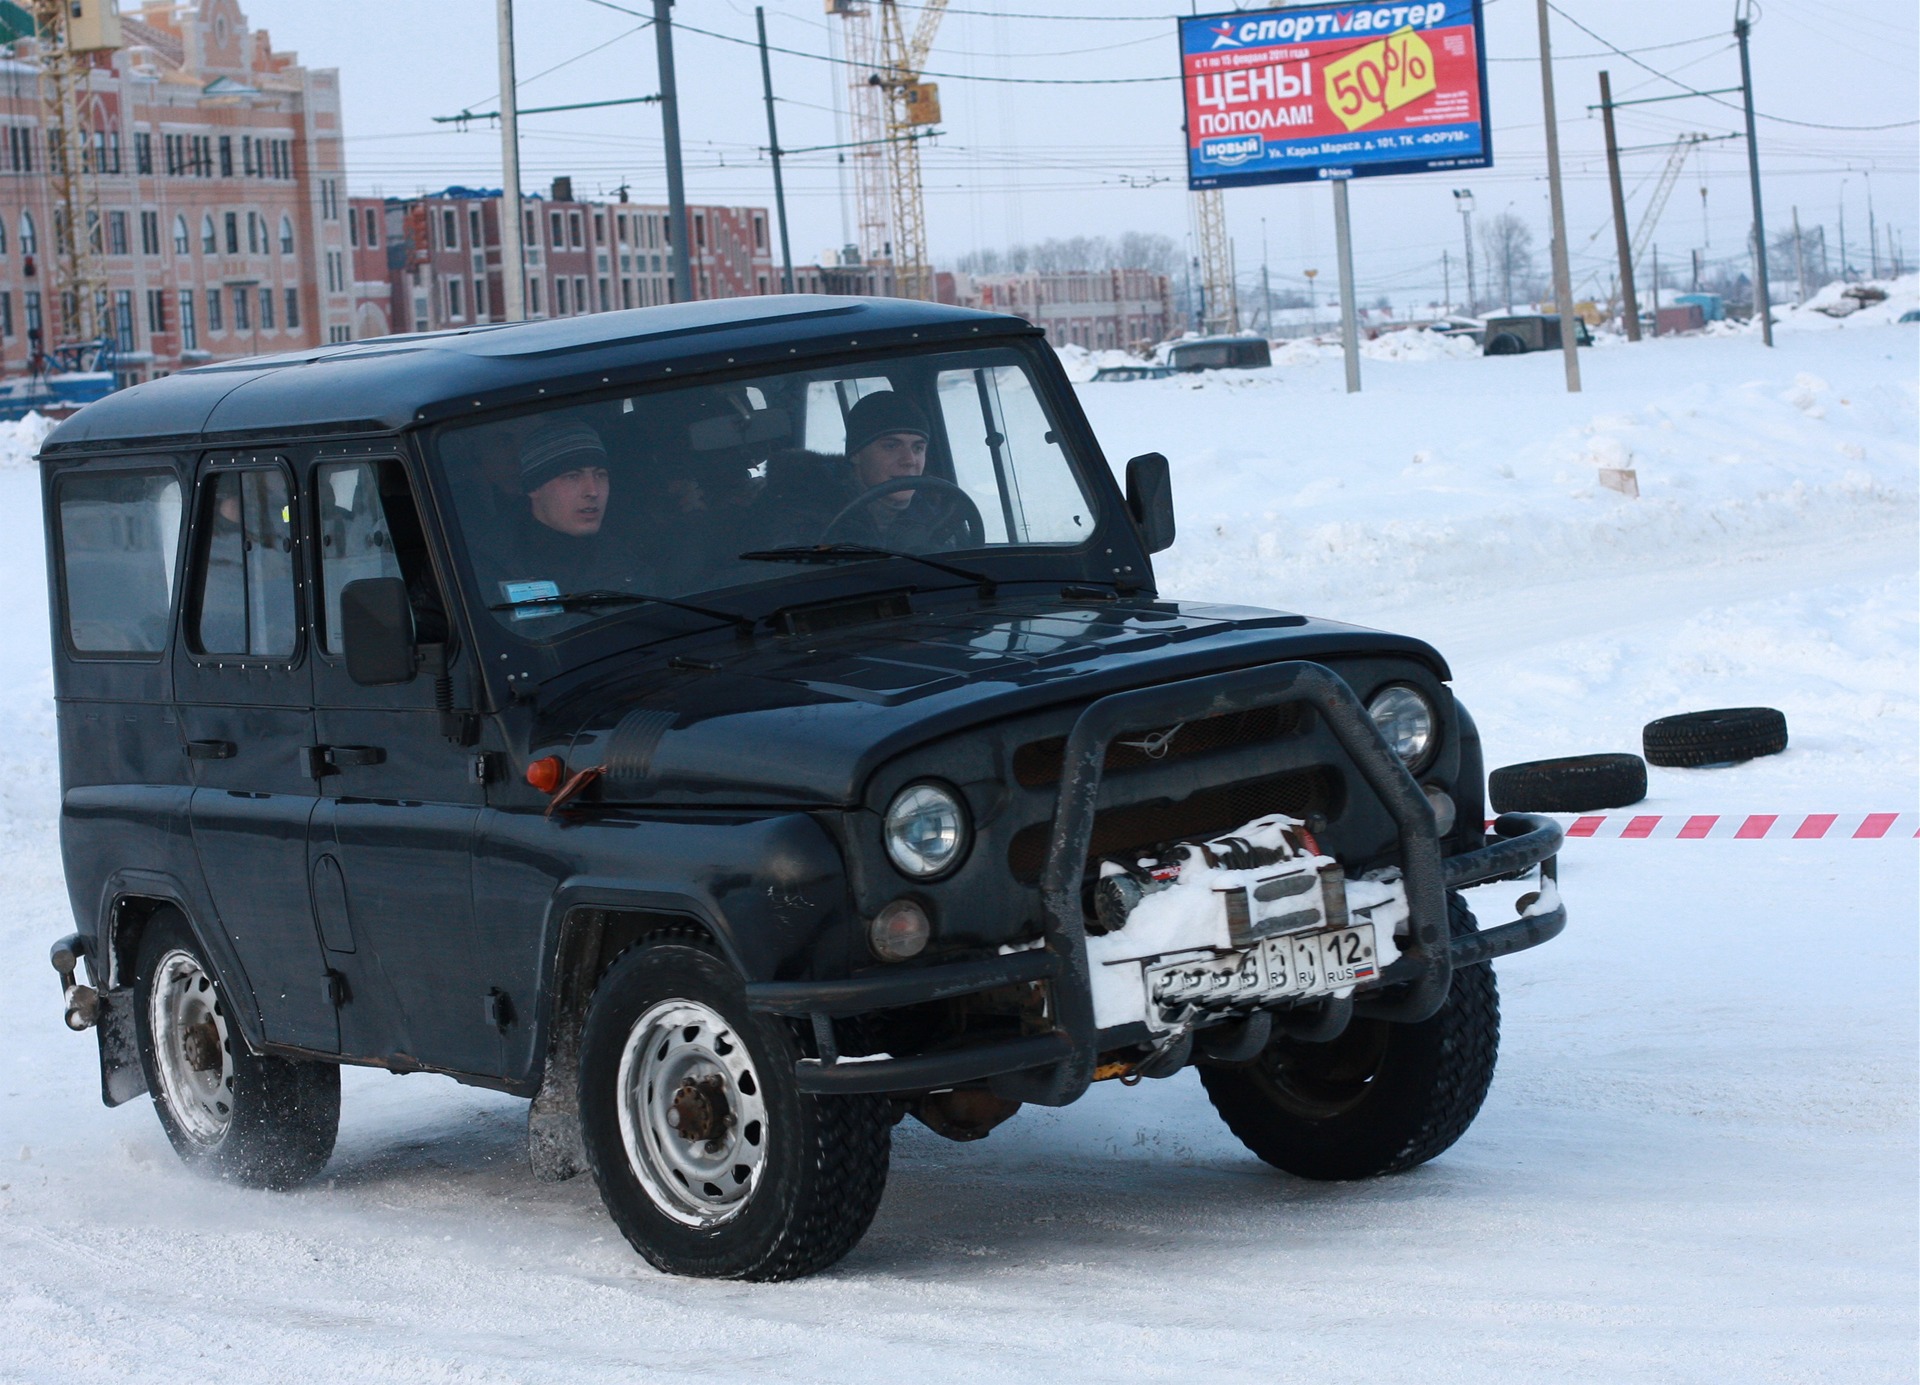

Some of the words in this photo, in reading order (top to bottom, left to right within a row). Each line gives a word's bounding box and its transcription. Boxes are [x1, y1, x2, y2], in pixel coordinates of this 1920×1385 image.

[1221, 55, 1232, 65] 15
[1269, 49, 1288, 61] 2011
[1290, 47, 1310, 60] года
[1196, 61, 1312, 111] ЦЕНЫ
[1332, 39, 1426, 116] 50%
[1199, 104, 1314, 135] ПОПОЛАМ!
[1286, 146, 1319, 158] Карла
[1399, 134, 1414, 146] ТК
[1327, 932, 1362, 966] 12
[1327, 968, 1354, 983] RUS
